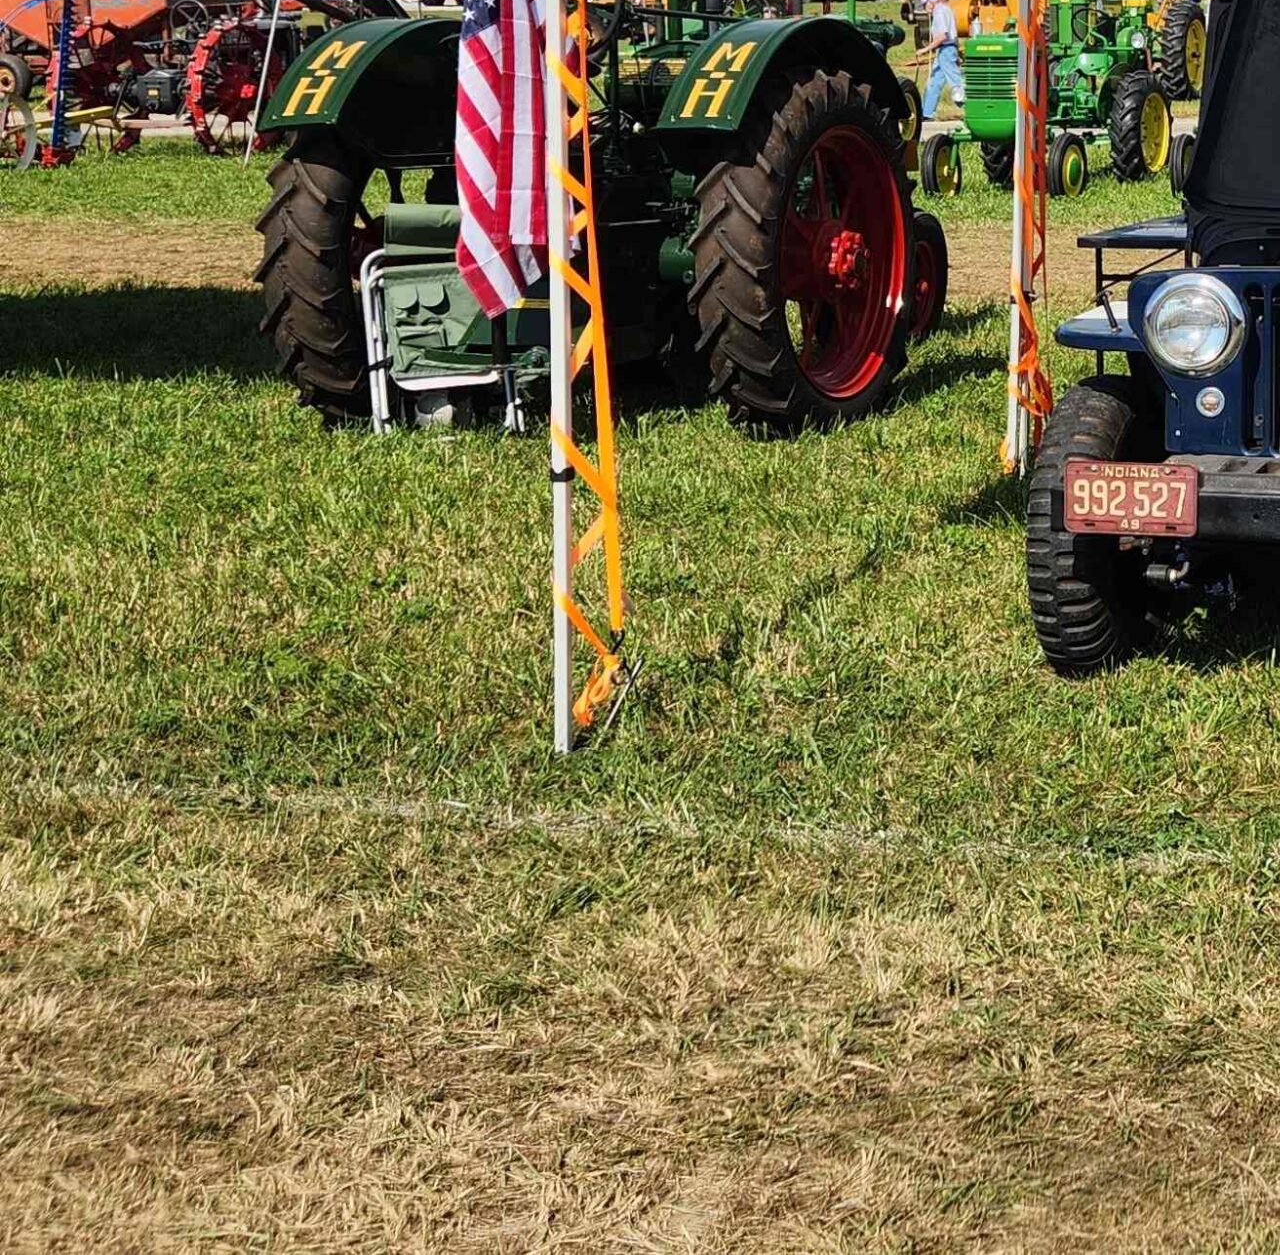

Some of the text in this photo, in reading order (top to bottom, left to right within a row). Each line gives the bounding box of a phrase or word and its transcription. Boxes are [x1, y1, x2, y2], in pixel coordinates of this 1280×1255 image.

[1101, 465, 1160, 478] INDIANA
[1073, 479, 1187, 519] 992 527
[1120, 518, 1140, 530] 49
